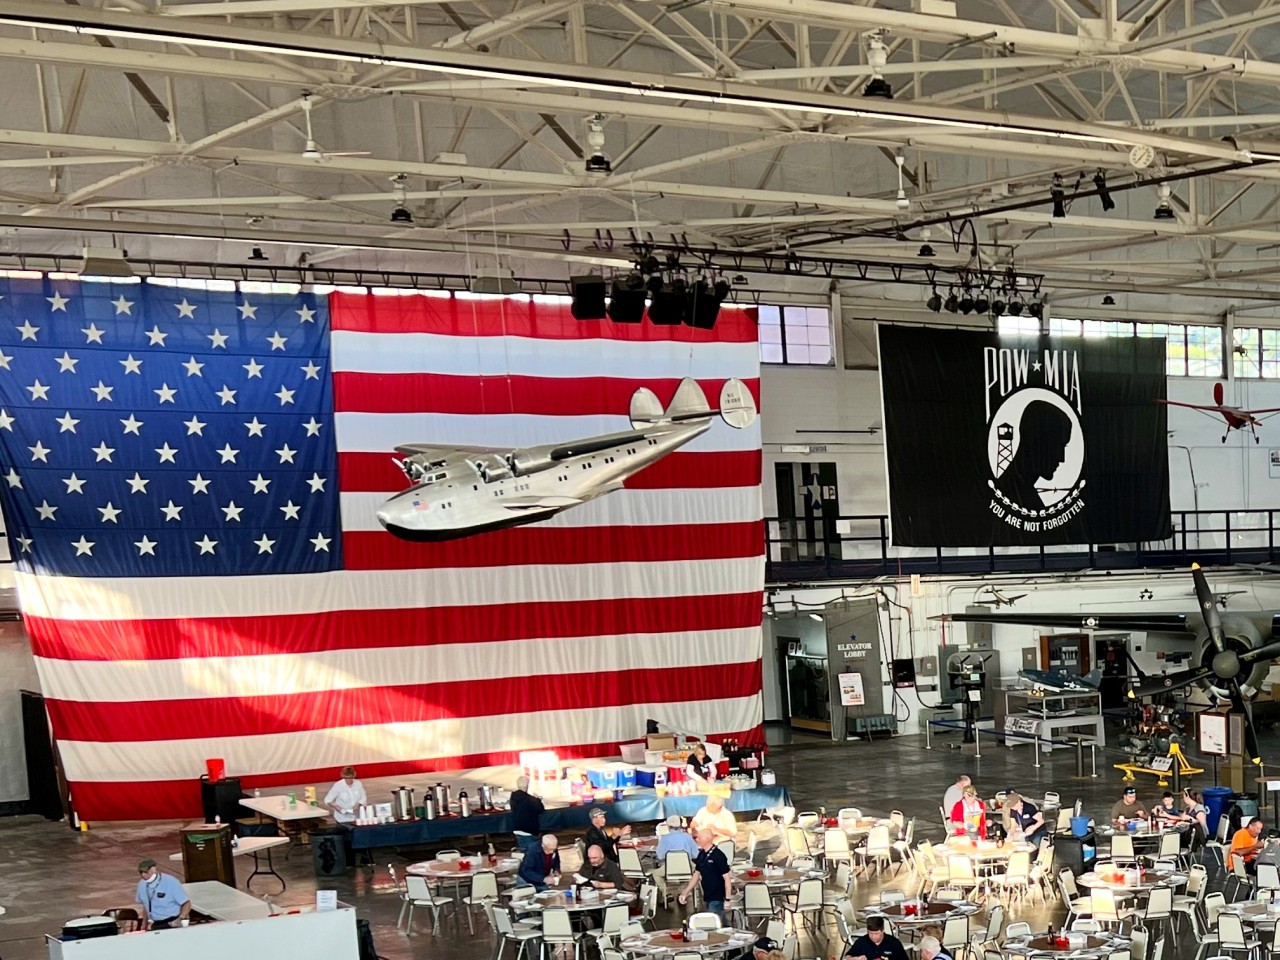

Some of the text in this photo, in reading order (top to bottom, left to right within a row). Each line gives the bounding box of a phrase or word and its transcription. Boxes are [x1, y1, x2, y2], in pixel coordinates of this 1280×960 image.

[983, 346, 1082, 425] POW MIA
[989, 498, 1086, 532] YOU ARE NOT FORGOTTEN
[837, 642, 872, 651] ELEVATOR
[843, 651, 867, 659] LOBBY
